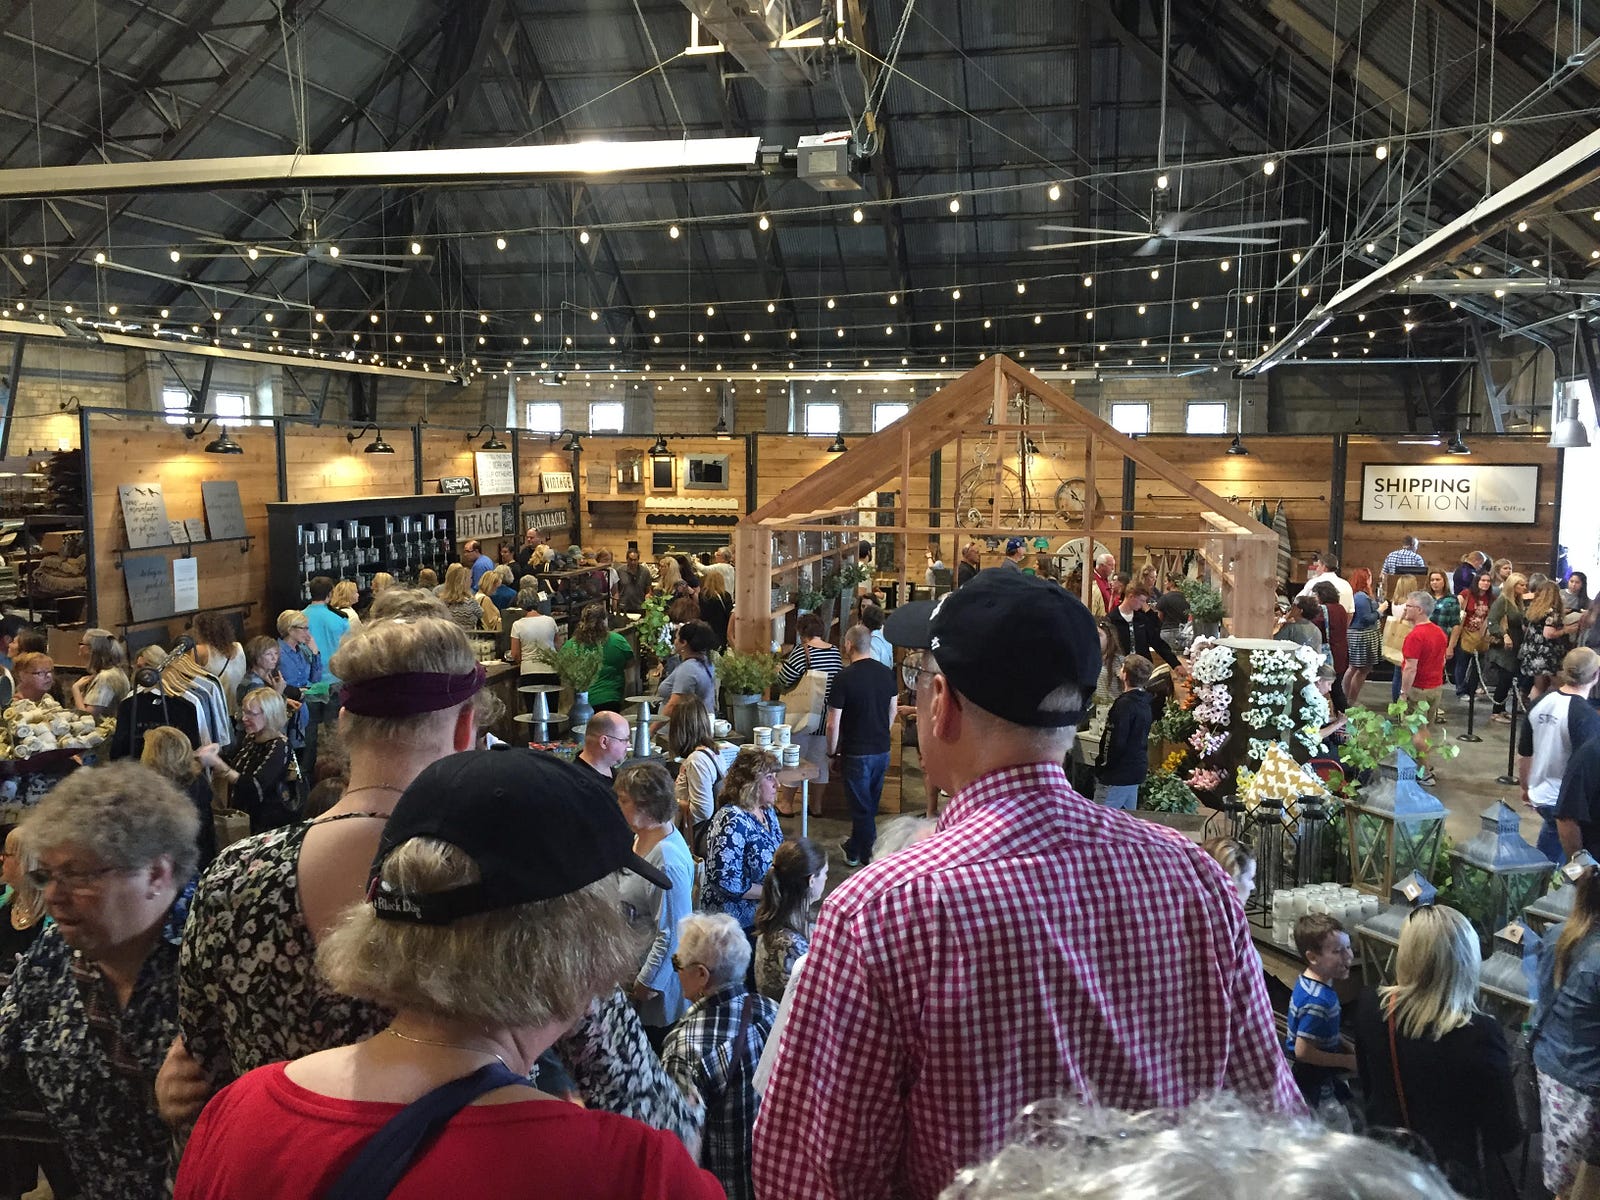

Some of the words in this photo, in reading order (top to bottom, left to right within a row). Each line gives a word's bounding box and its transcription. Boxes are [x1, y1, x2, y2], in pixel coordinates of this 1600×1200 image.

[1374, 478, 1470, 493] SHIPPING
[1373, 494, 1469, 510] STATION
[457, 512, 499, 536] INTAGE
[526, 511, 567, 529] PHARMACIE
